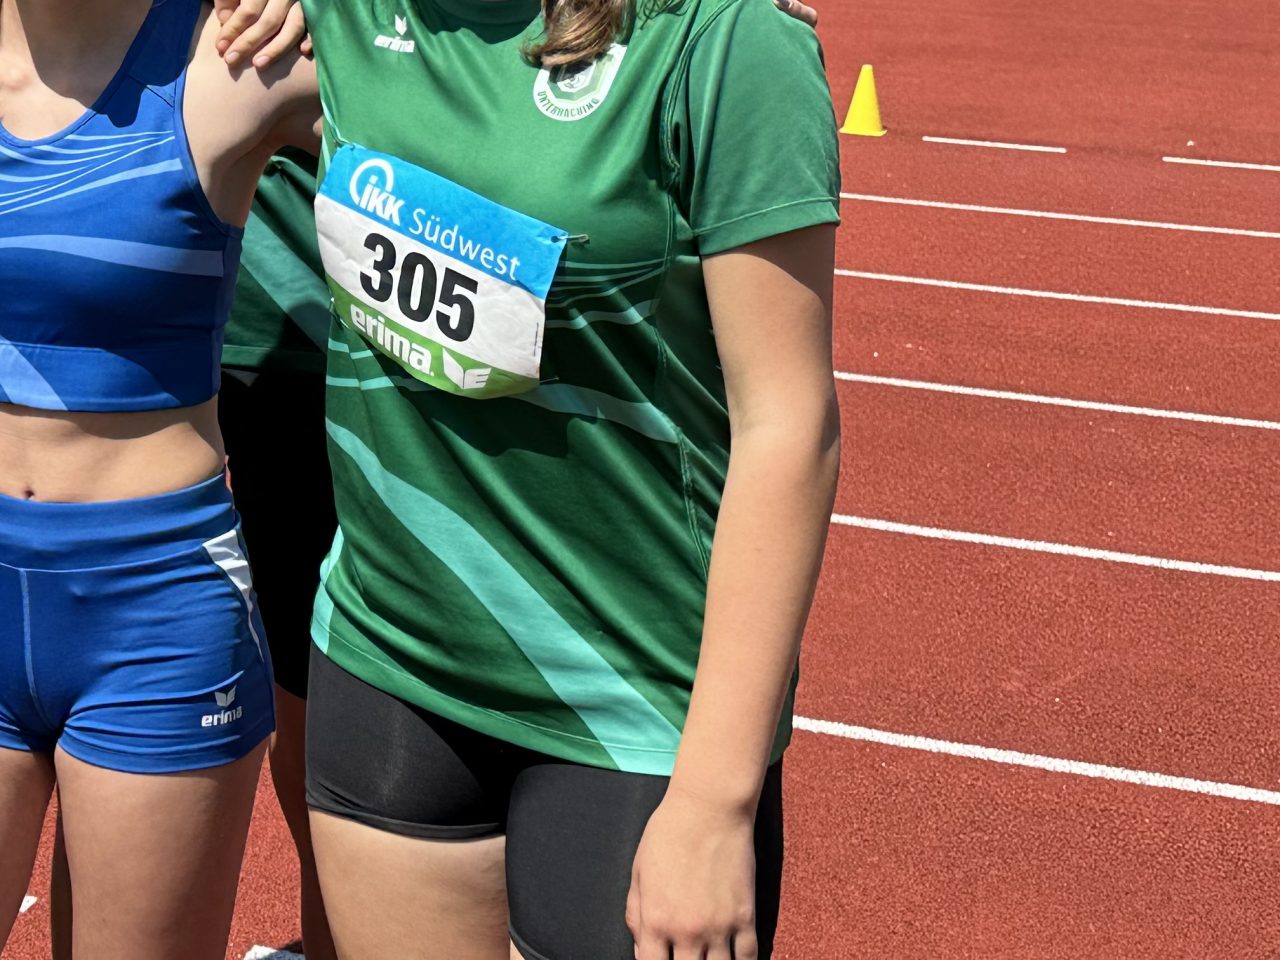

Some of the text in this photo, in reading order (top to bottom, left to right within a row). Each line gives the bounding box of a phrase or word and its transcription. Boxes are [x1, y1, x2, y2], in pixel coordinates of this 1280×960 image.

[409, 208, 521, 281] Südwest
[359, 232, 479, 343] 305
[201, 705, 243, 727] erima
